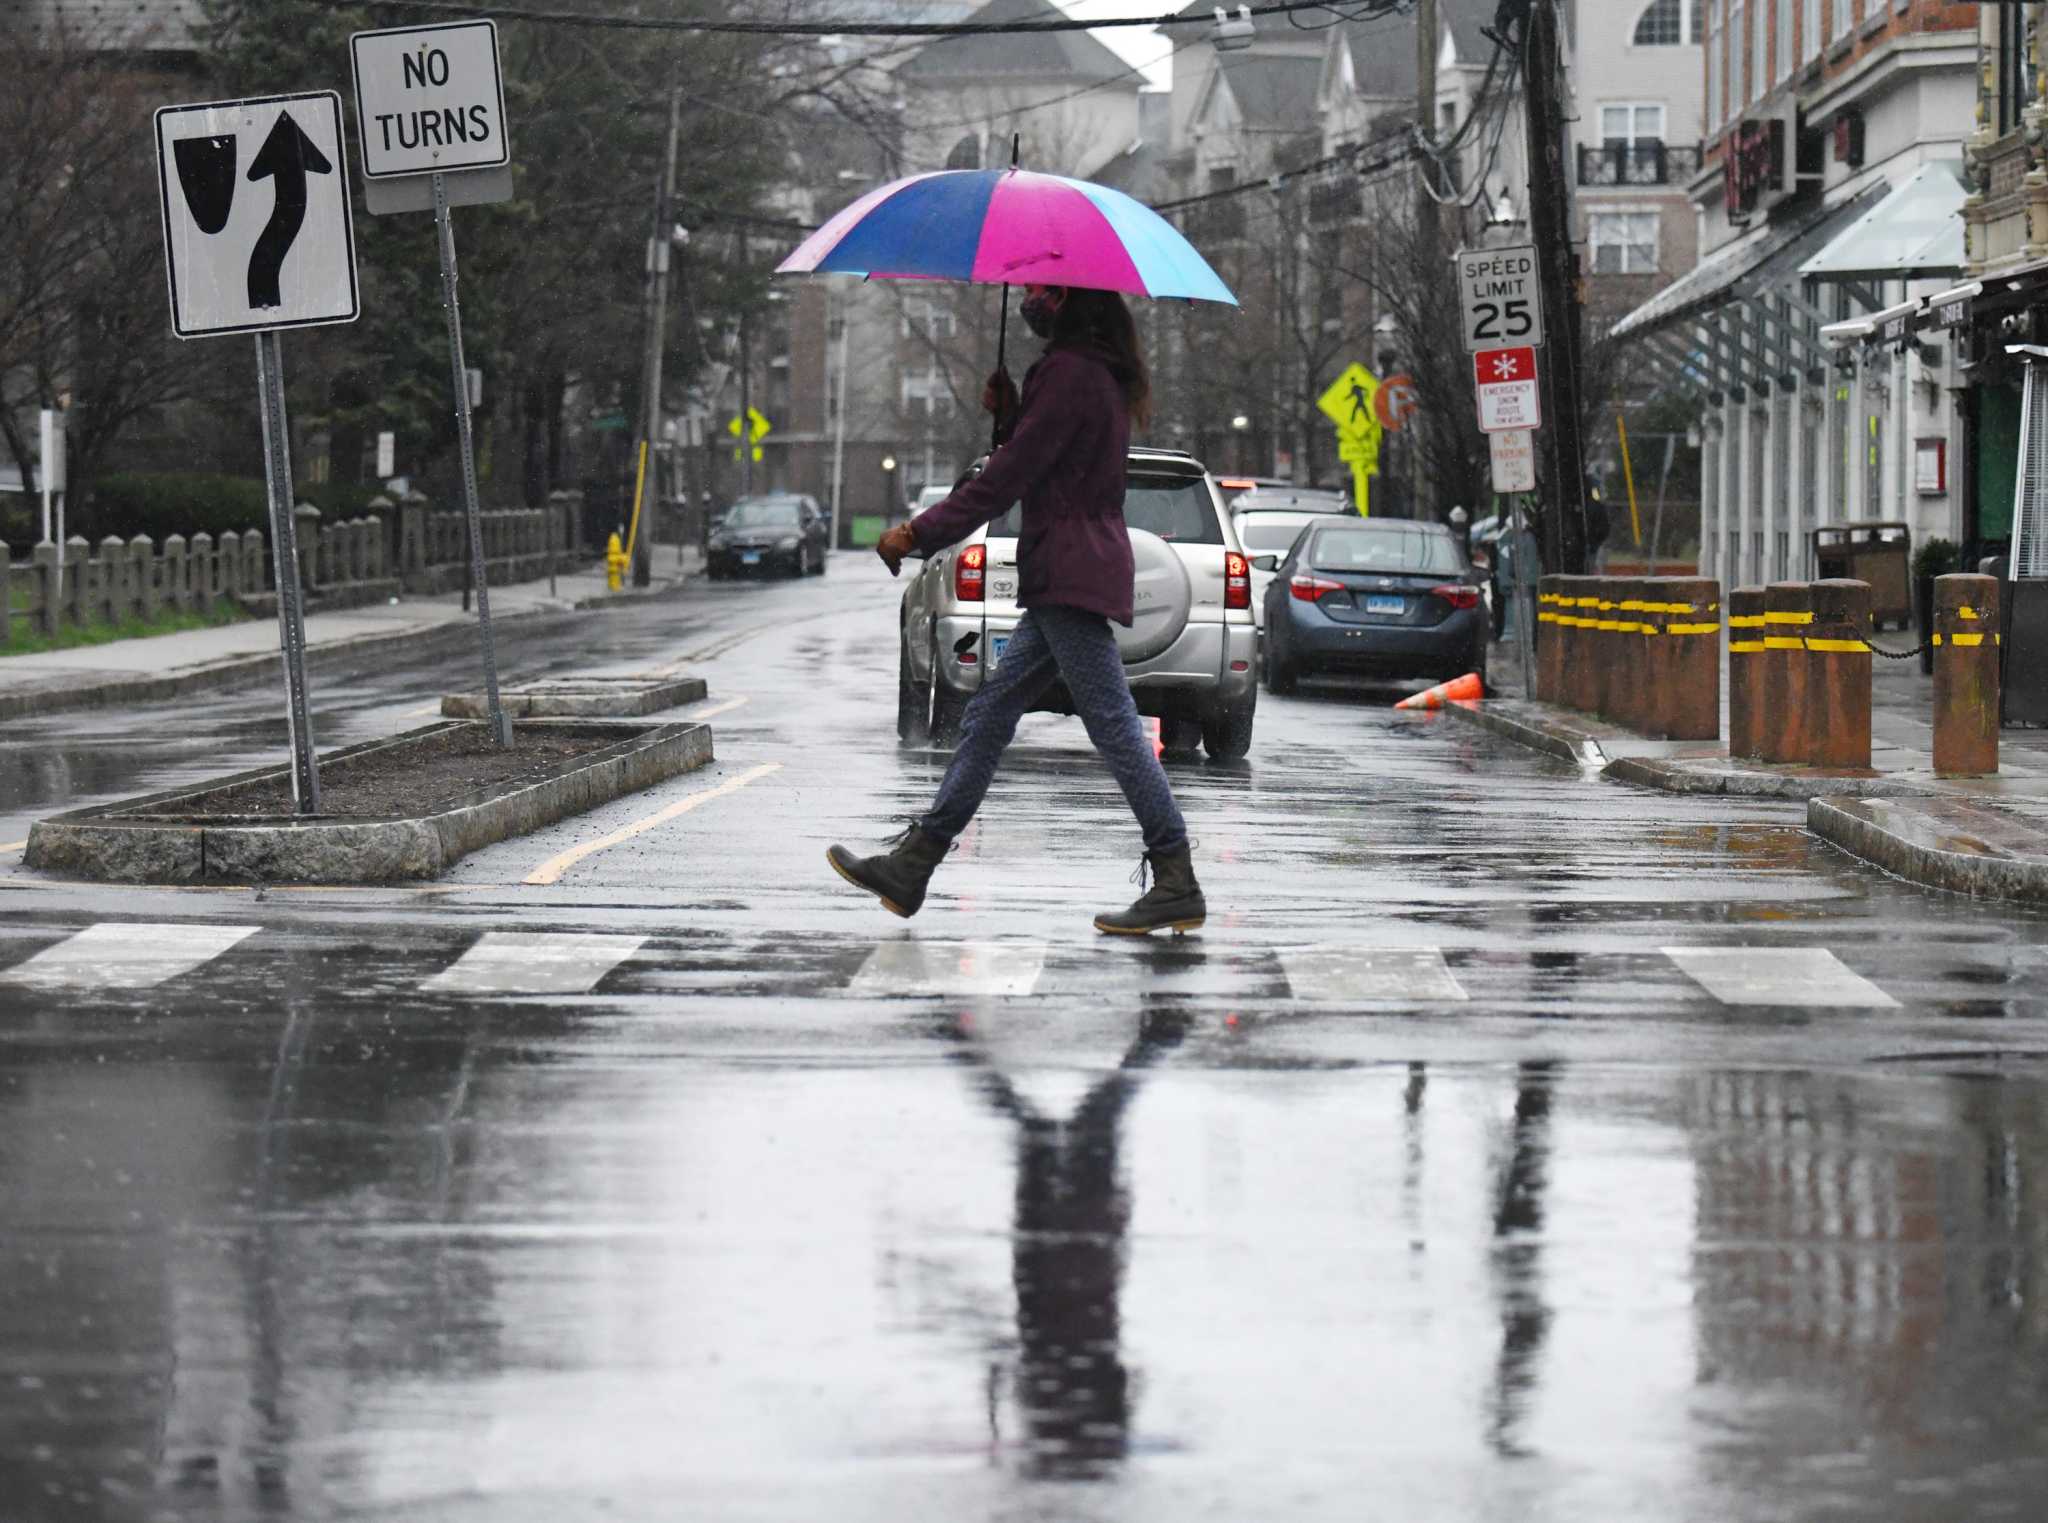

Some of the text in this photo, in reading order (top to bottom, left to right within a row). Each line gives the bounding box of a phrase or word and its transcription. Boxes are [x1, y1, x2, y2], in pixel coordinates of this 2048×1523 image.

[402, 48, 449, 89] NO
[375, 104, 489, 151] TURNS
[1465, 257, 1531, 279] SPEED
[1473, 279, 1525, 298] LIMIT
[1471, 300, 1532, 340] 25
[1483, 383, 1531, 397] EMERGENCY
[1496, 405, 1520, 415] ROUTE
[1497, 396, 1519, 406] SNOW
